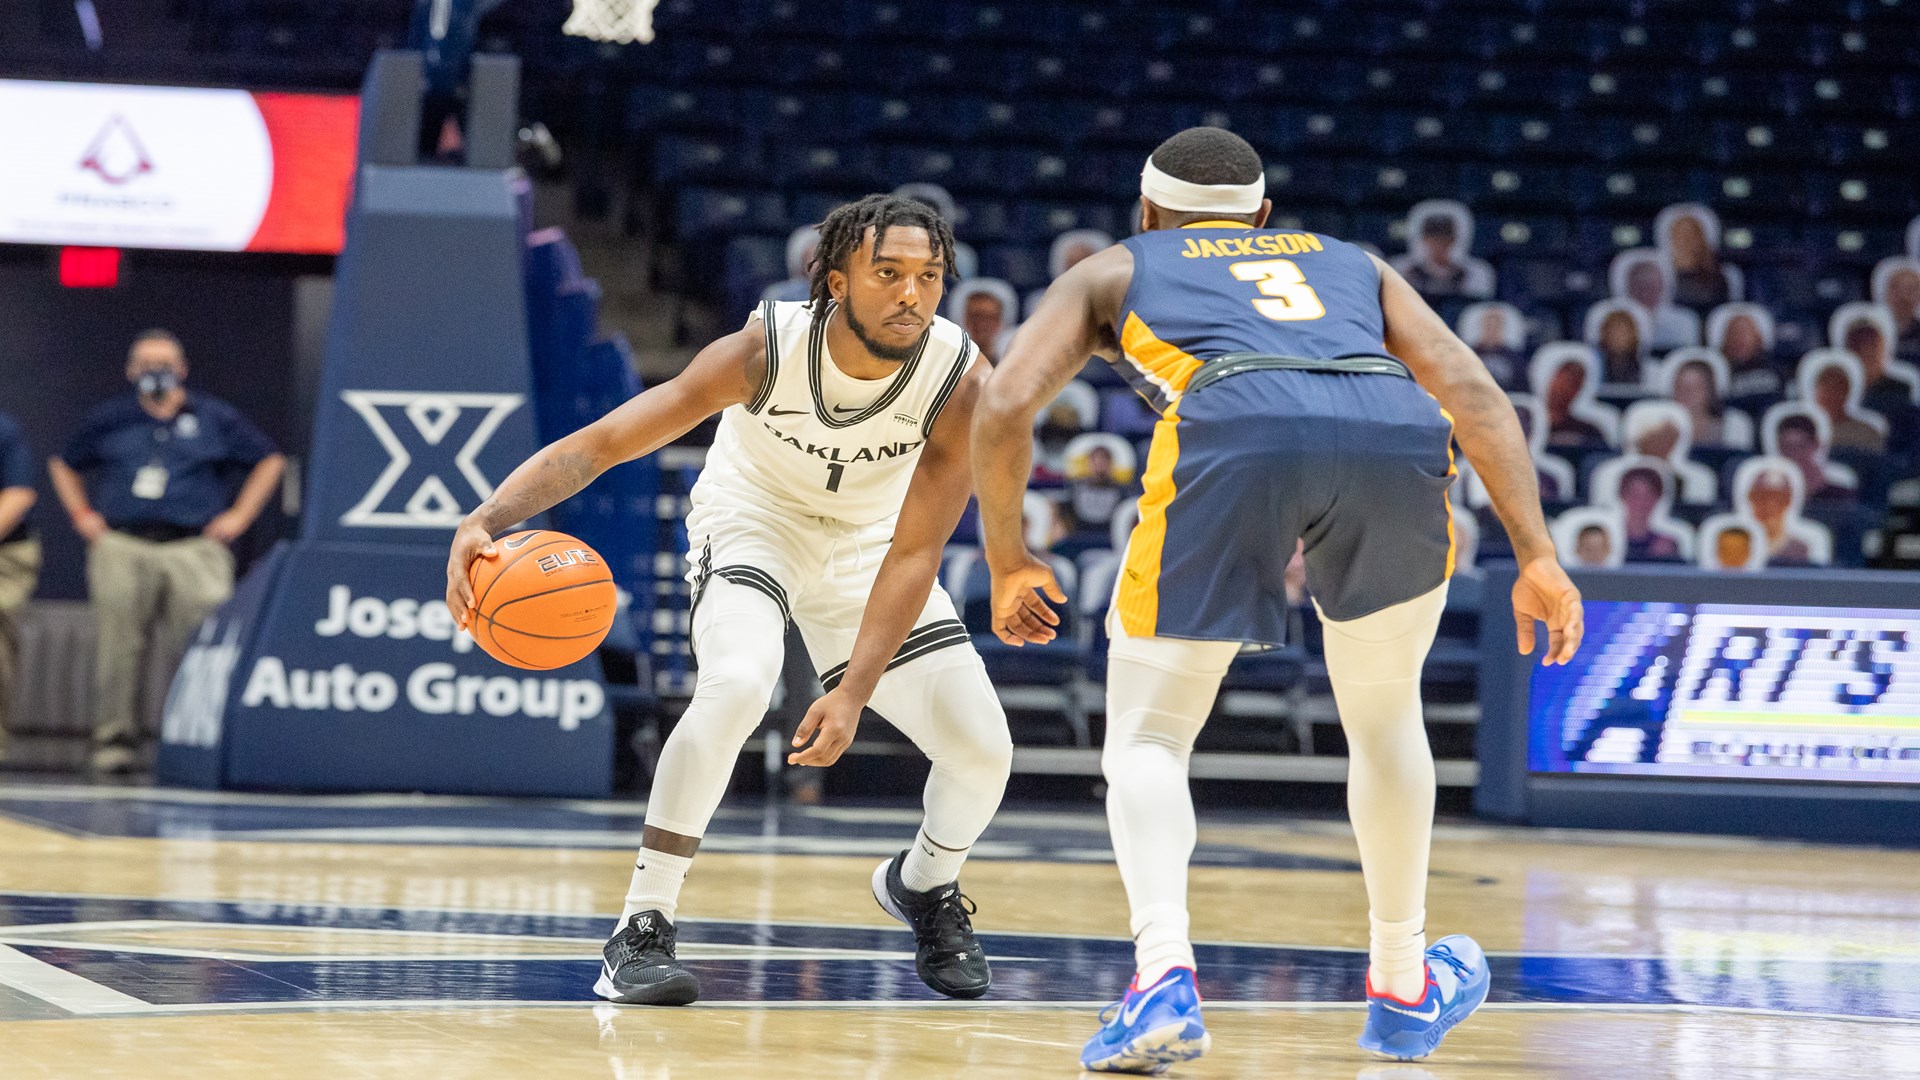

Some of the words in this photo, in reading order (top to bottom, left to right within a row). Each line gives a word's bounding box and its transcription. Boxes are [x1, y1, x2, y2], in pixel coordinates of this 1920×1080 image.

[1181, 233, 1324, 259] JACKSON
[1228, 258, 1327, 321] 3
[763, 422, 922, 463] OAKLAND
[825, 462, 845, 493] 1
[535, 549, 598, 573] ELITE
[242, 656, 399, 713] Auto
[406, 662, 605, 731] Group
